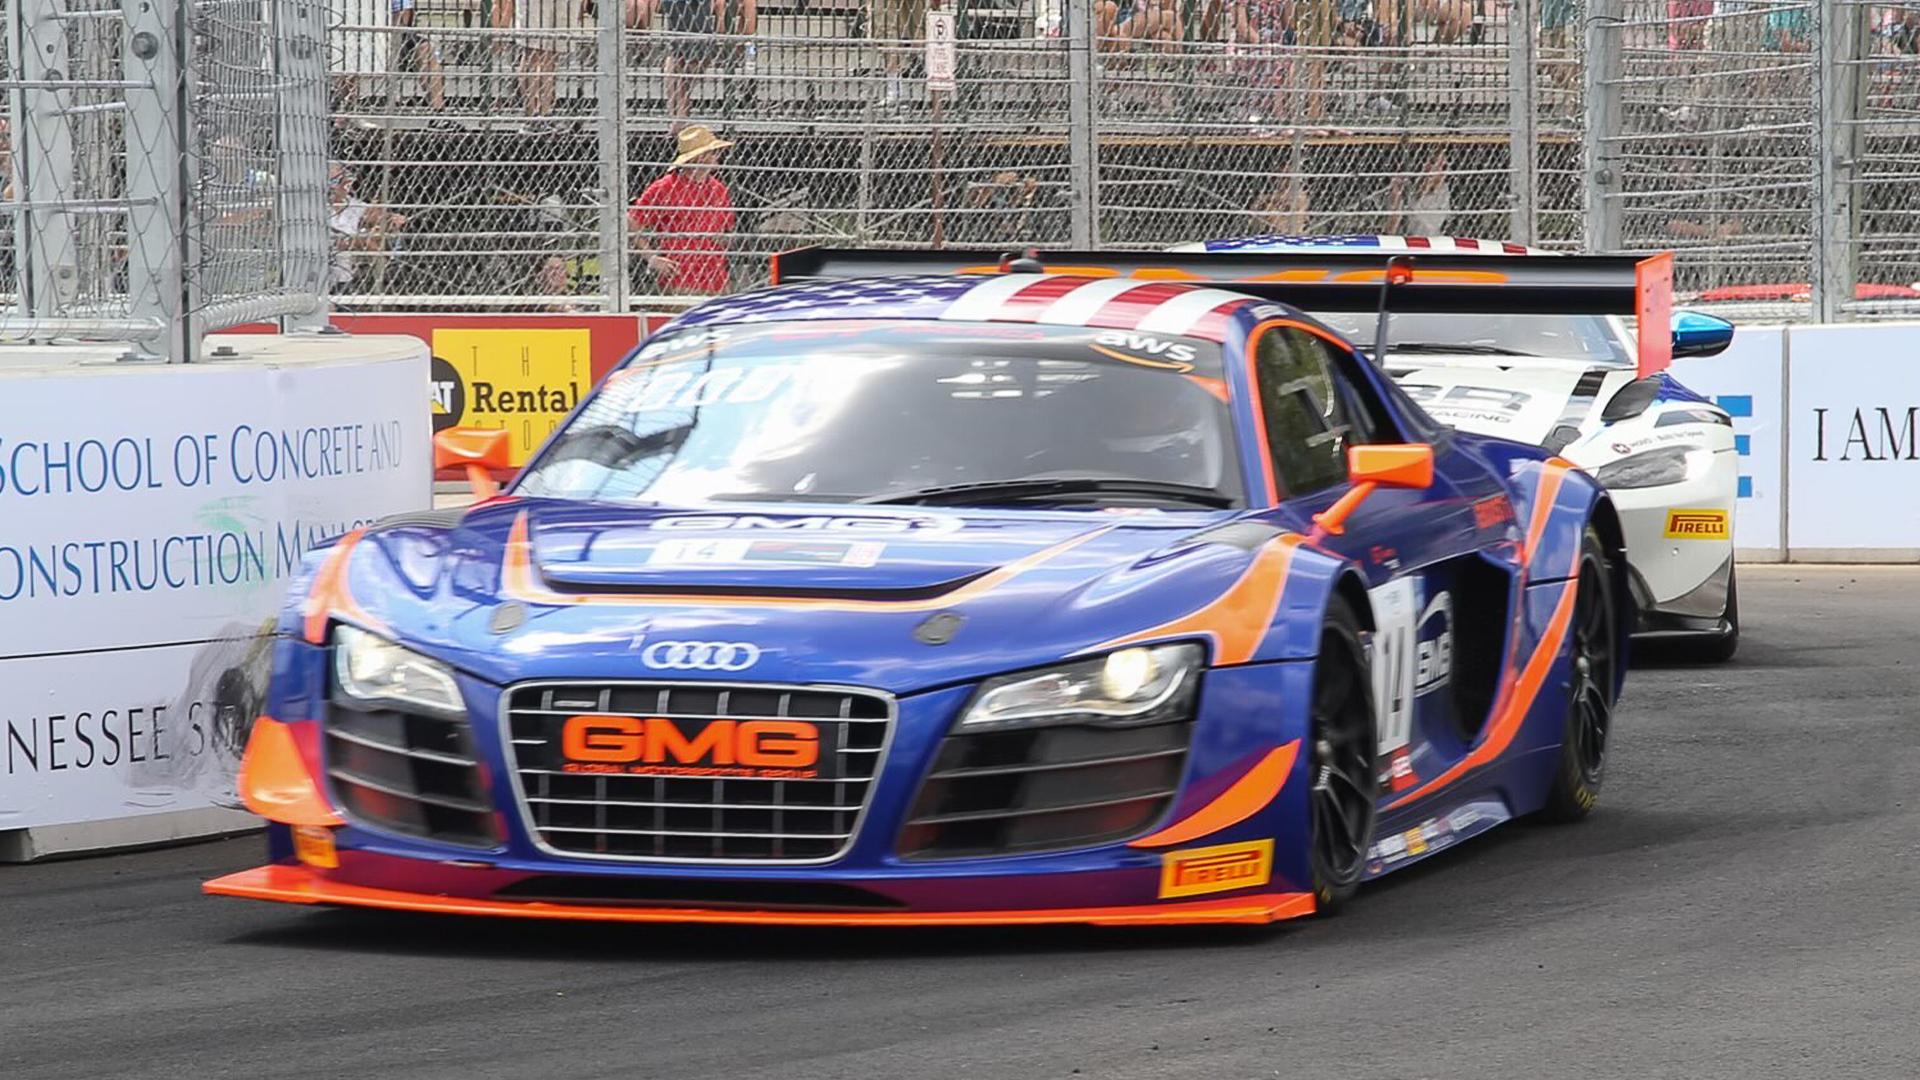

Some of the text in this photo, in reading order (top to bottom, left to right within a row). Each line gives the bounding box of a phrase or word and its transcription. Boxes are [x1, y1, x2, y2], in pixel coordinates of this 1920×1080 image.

[1095, 333, 1197, 362] aws
[472, 382, 578, 413] Rental
[174, 434, 218, 487] OF
[230, 424, 364, 484] CONCRETE
[370, 420, 402, 468] AND
[1812, 408, 1828, 461] I
[1839, 406, 1920, 461] AM
[1670, 514, 1724, 533] PIRELLI
[7, 704, 170, 774] NESSEE
[562, 714, 819, 768] GMG
